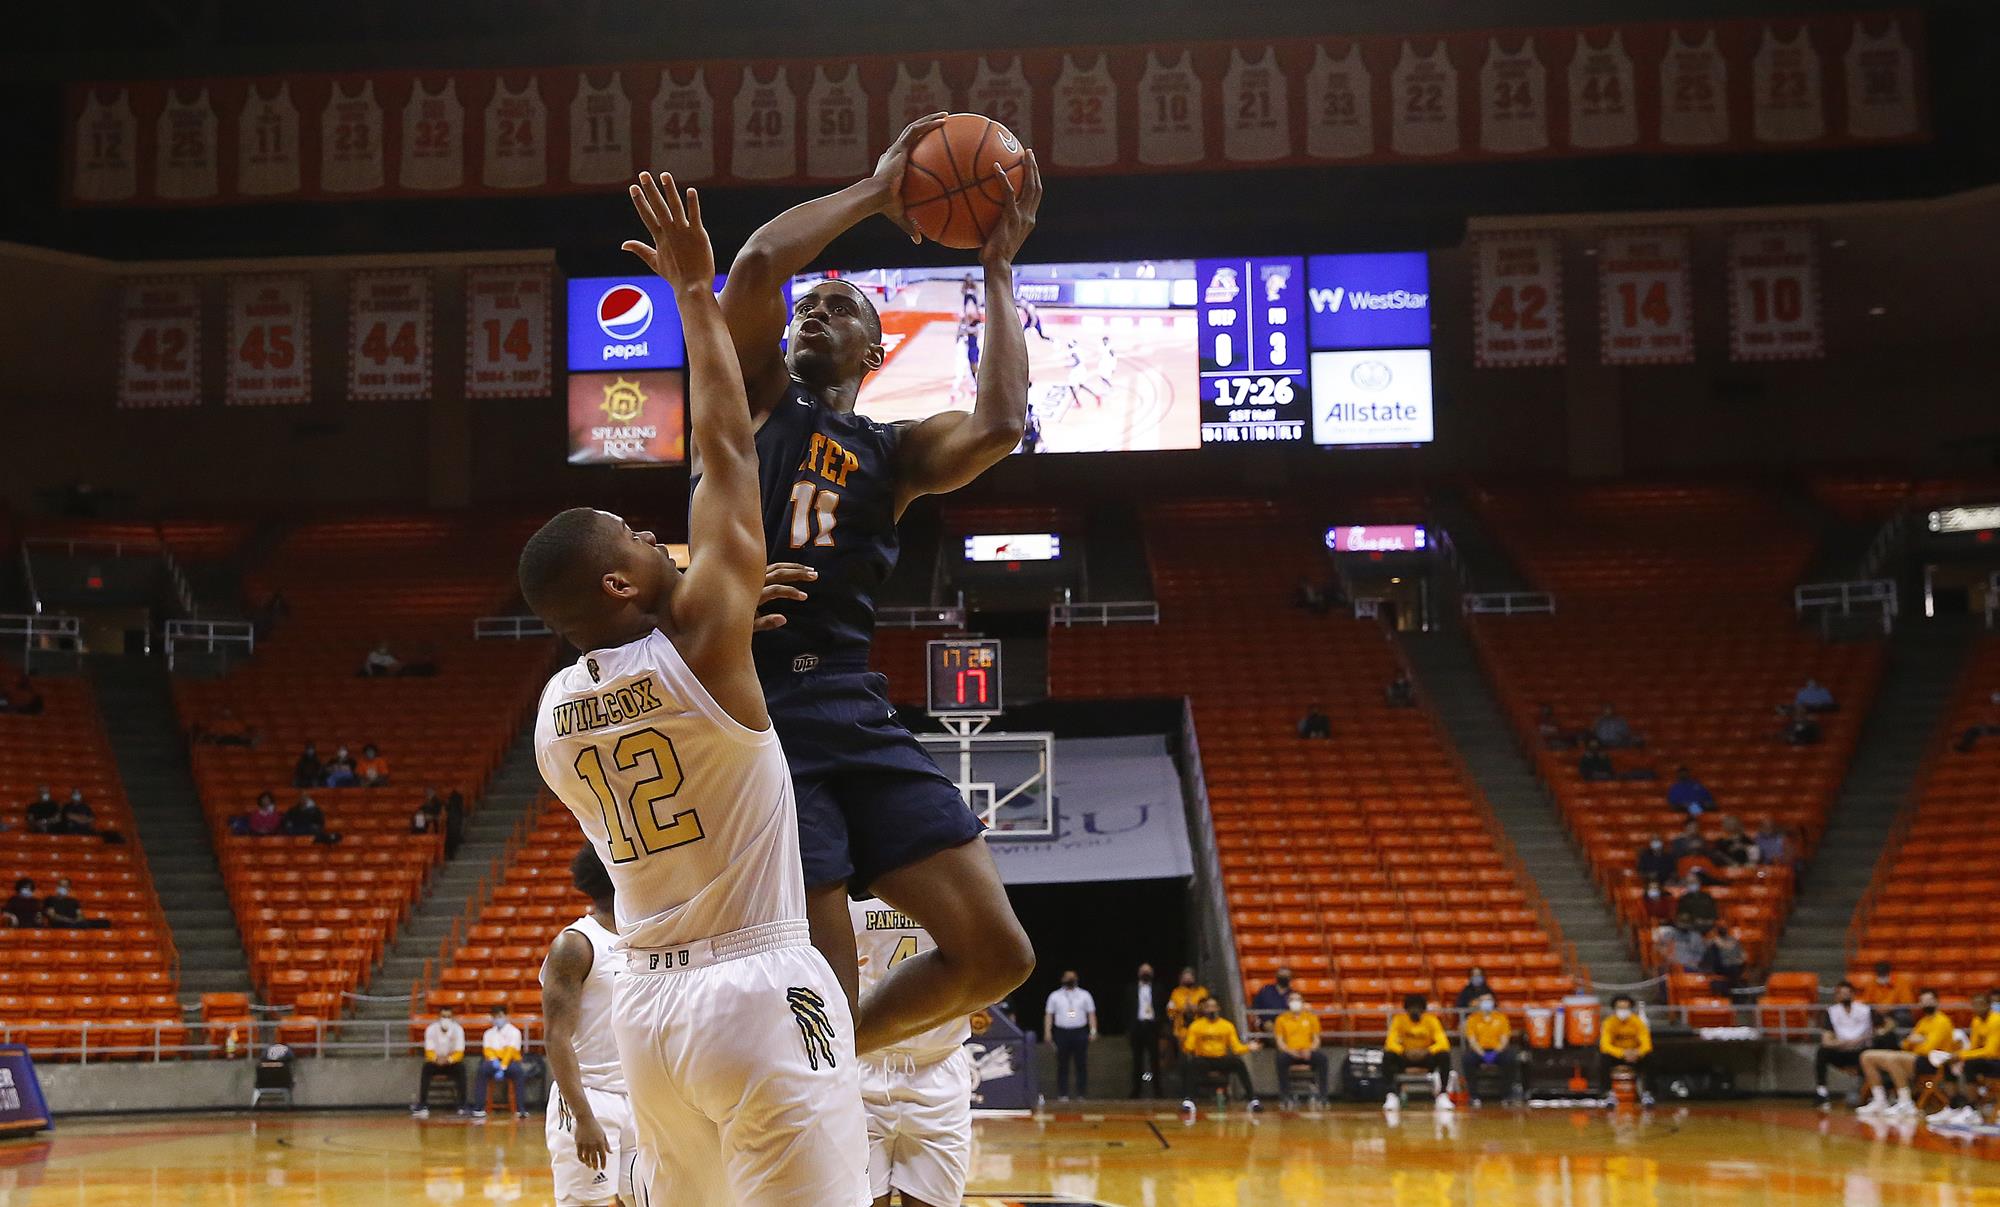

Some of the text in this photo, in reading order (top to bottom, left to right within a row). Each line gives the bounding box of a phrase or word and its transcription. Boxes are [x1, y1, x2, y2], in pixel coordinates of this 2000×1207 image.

[1155, 94, 1188, 123] 10
[1239, 91, 1271, 119] 21
[1406, 84, 1443, 113] 22
[587, 115, 615, 144] 11
[664, 111, 701, 139] 44
[746, 109, 782, 138] 40
[819, 108, 856, 136] 50
[256, 124, 282, 154] 11
[1348, 289, 1429, 311] WestStar
[1487, 284, 1548, 331] 42
[1618, 280, 1671, 328] 14
[1746, 276, 1801, 325] 10
[131, 327, 188, 372] 42
[239, 325, 296, 370] 45
[361, 320, 419, 366] 44
[483, 318, 532, 363] 14
[603, 341, 648, 361] pepsi
[1269, 331, 1287, 366] 3
[1214, 376, 1295, 406] 17:26
[1325, 402, 1417, 423] Allstate
[591, 425, 657, 441] SPEAKING
[603, 439, 646, 460] ROCK
[798, 431, 860, 488] TEP
[789, 480, 840, 549] 11
[956, 669, 987, 705] 17
[552, 677, 662, 737] WILCOX
[574, 726, 706, 864] 12
[649, 949, 690, 970] FIU
